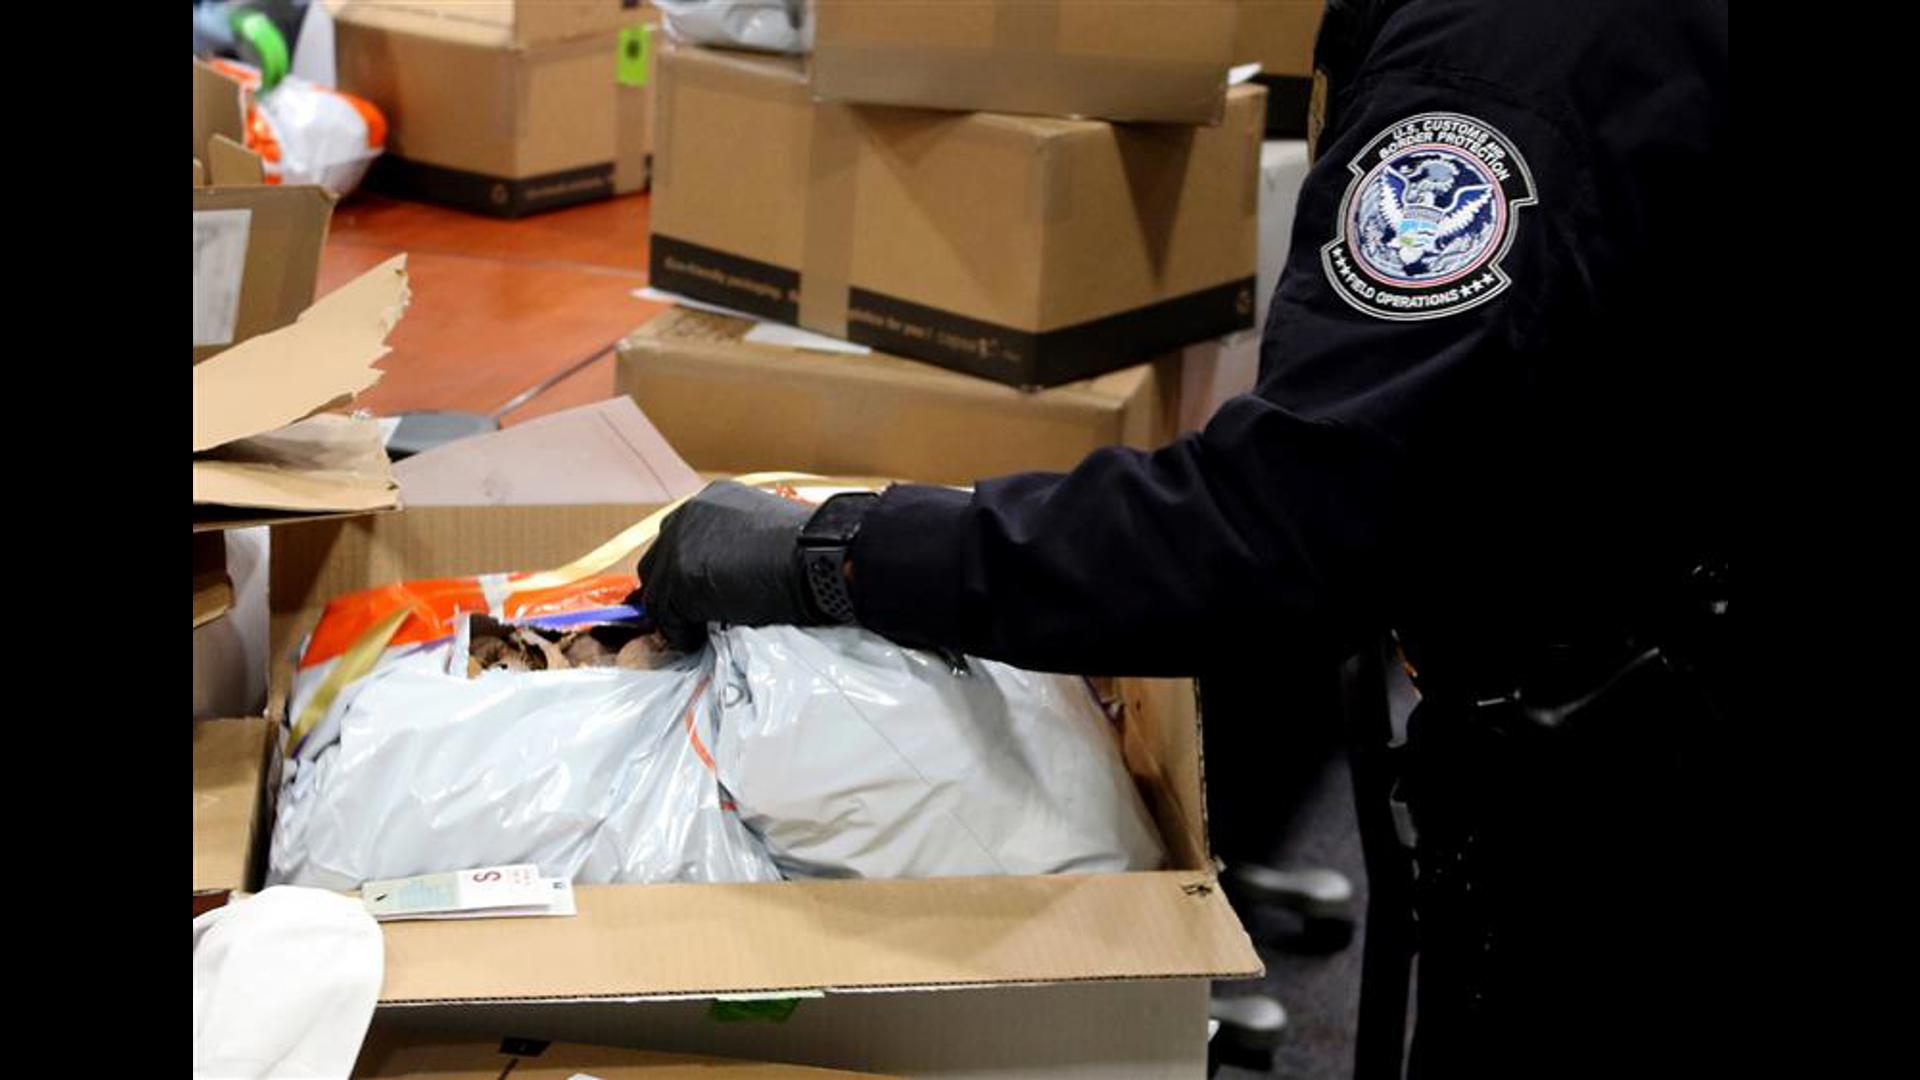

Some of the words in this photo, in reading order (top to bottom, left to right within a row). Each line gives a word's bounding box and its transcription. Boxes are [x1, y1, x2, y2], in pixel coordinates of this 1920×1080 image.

[1393, 124, 1419, 140] U.S.
[1422, 119, 1489, 143] CUSTOMS
[1378, 132, 1433, 160] BORDER
[1436, 131, 1511, 182] PROTECTION
[1345, 273, 1375, 299] FIELD
[1375, 288, 1460, 308] OPERATIONS
[472, 870, 501, 883] S
